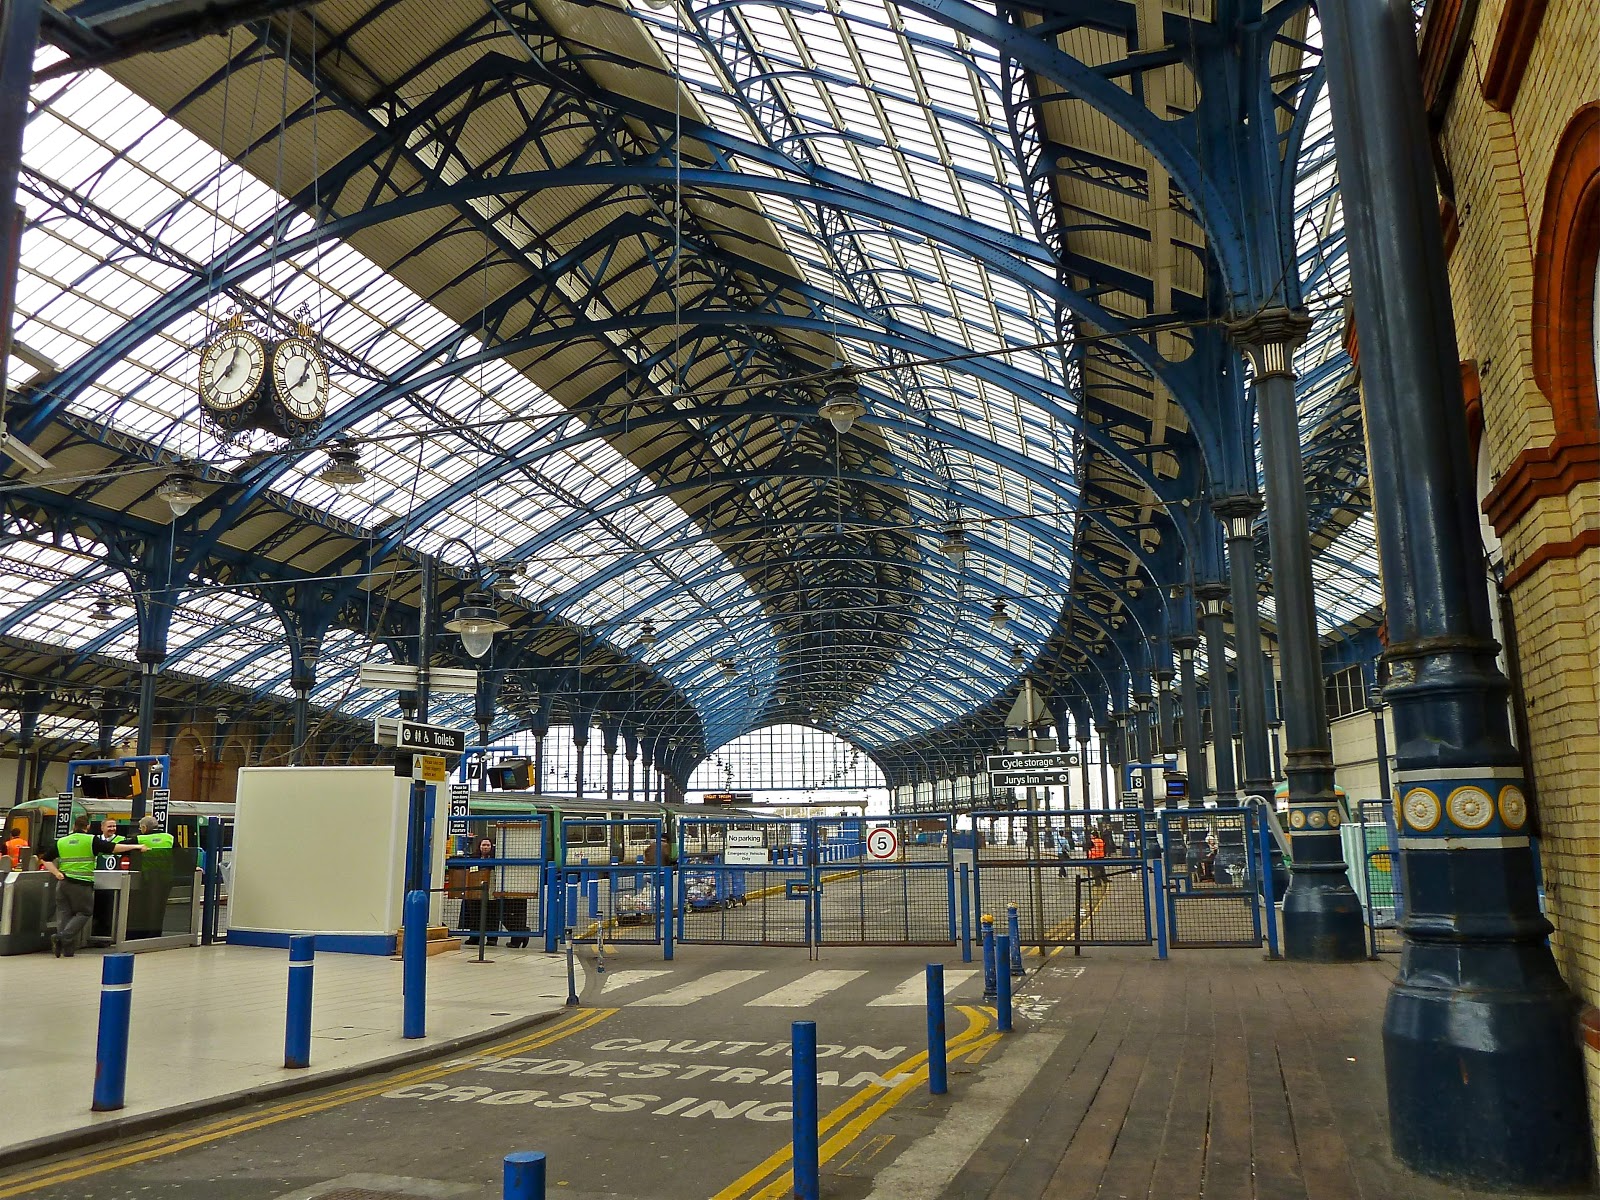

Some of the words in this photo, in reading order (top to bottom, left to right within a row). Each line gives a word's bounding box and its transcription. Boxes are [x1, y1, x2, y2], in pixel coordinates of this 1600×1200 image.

[433, 732, 455, 746] Toilets
[1002, 759, 1023, 770] Cycle
[1024, 758, 1054, 767] storage
[471, 765, 478, 778] 7
[75, 775, 82, 787] 5
[152, 774, 159, 786] 6
[1004, 775, 1026, 785] Jurys
[1027, 775, 1040, 784] Inn
[1135, 777, 1142, 787] 8
[155, 811, 166, 822] 30
[453, 805, 466, 817] 30
[58, 813, 70, 823] 30
[876, 836, 888, 850] 5
[591, 1038, 907, 1060] CAUTION
[439, 1055, 915, 1089] PEDESTRIAN
[381, 1083, 794, 1121] CROSSING
